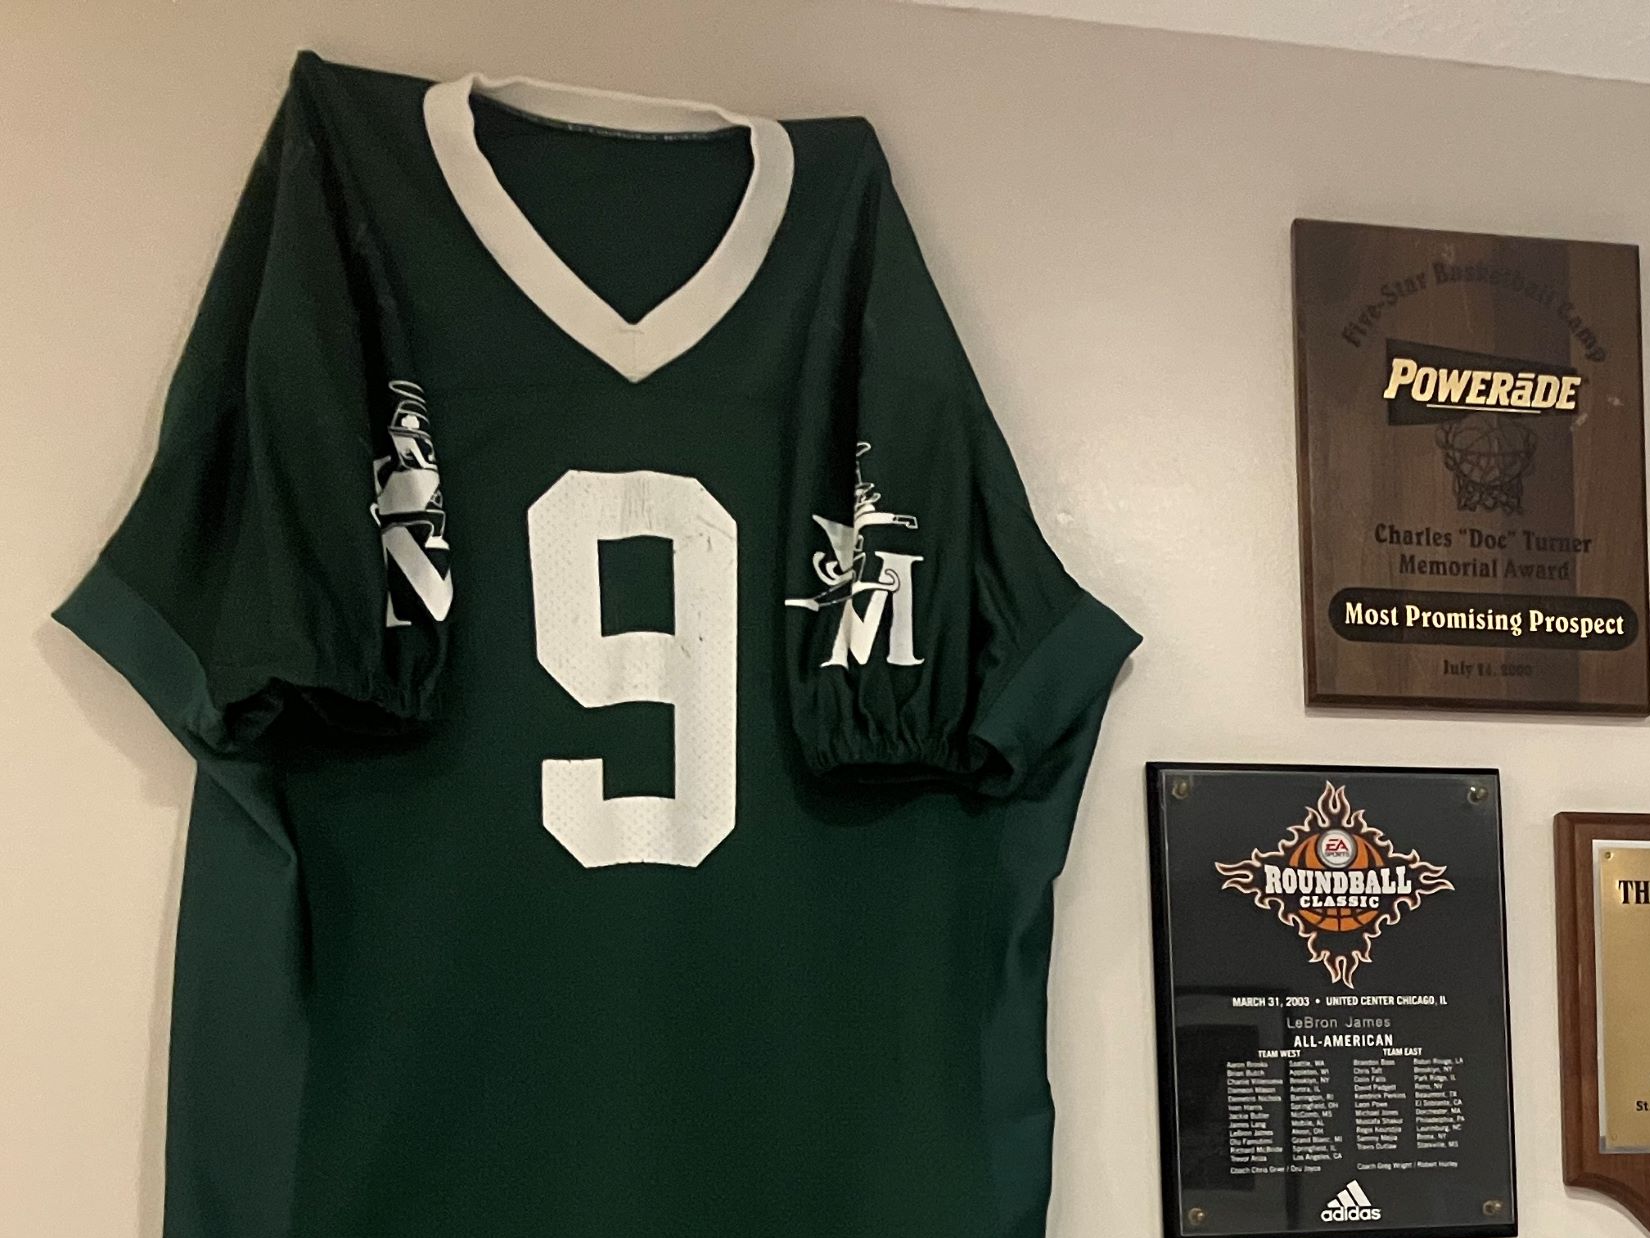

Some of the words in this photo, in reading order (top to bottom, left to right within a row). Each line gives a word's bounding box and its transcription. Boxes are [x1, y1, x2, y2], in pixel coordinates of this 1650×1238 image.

[1374, 523, 1452, 548] Charles
[1522, 531, 1592, 553] Turner
[1399, 554, 1497, 577] Memorial
[1503, 560, 1570, 581] Award
[1345, 601, 1399, 626] Most
[1405, 605, 1523, 637] Promising
[1528, 610, 1625, 638] Prospect
[527, 470, 737, 868] 9
[1325, 838, 1349, 851] EA
[1264, 864, 1412, 894] ROUNDBALL
[1300, 896, 1379, 908] CLASSIC
[1232, 997, 1266, 1007] MARCH
[1268, 997, 1283, 1008] 31,
[1285, 996, 1310, 1006] 2003
[1326, 996, 1359, 1006] UNITED
[1360, 996, 1395, 1006] CENTER
[1396, 995, 1438, 1006] CHICAGO,
[1440, 995, 1448, 1005] IL
[1286, 1017, 1338, 1029] LeBron
[1345, 1016, 1391, 1028] James
[1293, 1034, 1393, 1048] ALL-AMERICAN
[1258, 1050, 1278, 1058] TEAM
[1280, 1050, 1301, 1058] WEST
[1383, 1048, 1403, 1056] TEAM
[1404, 1048, 1422, 1056] EAST
[1321, 1206, 1381, 1222] adidas
